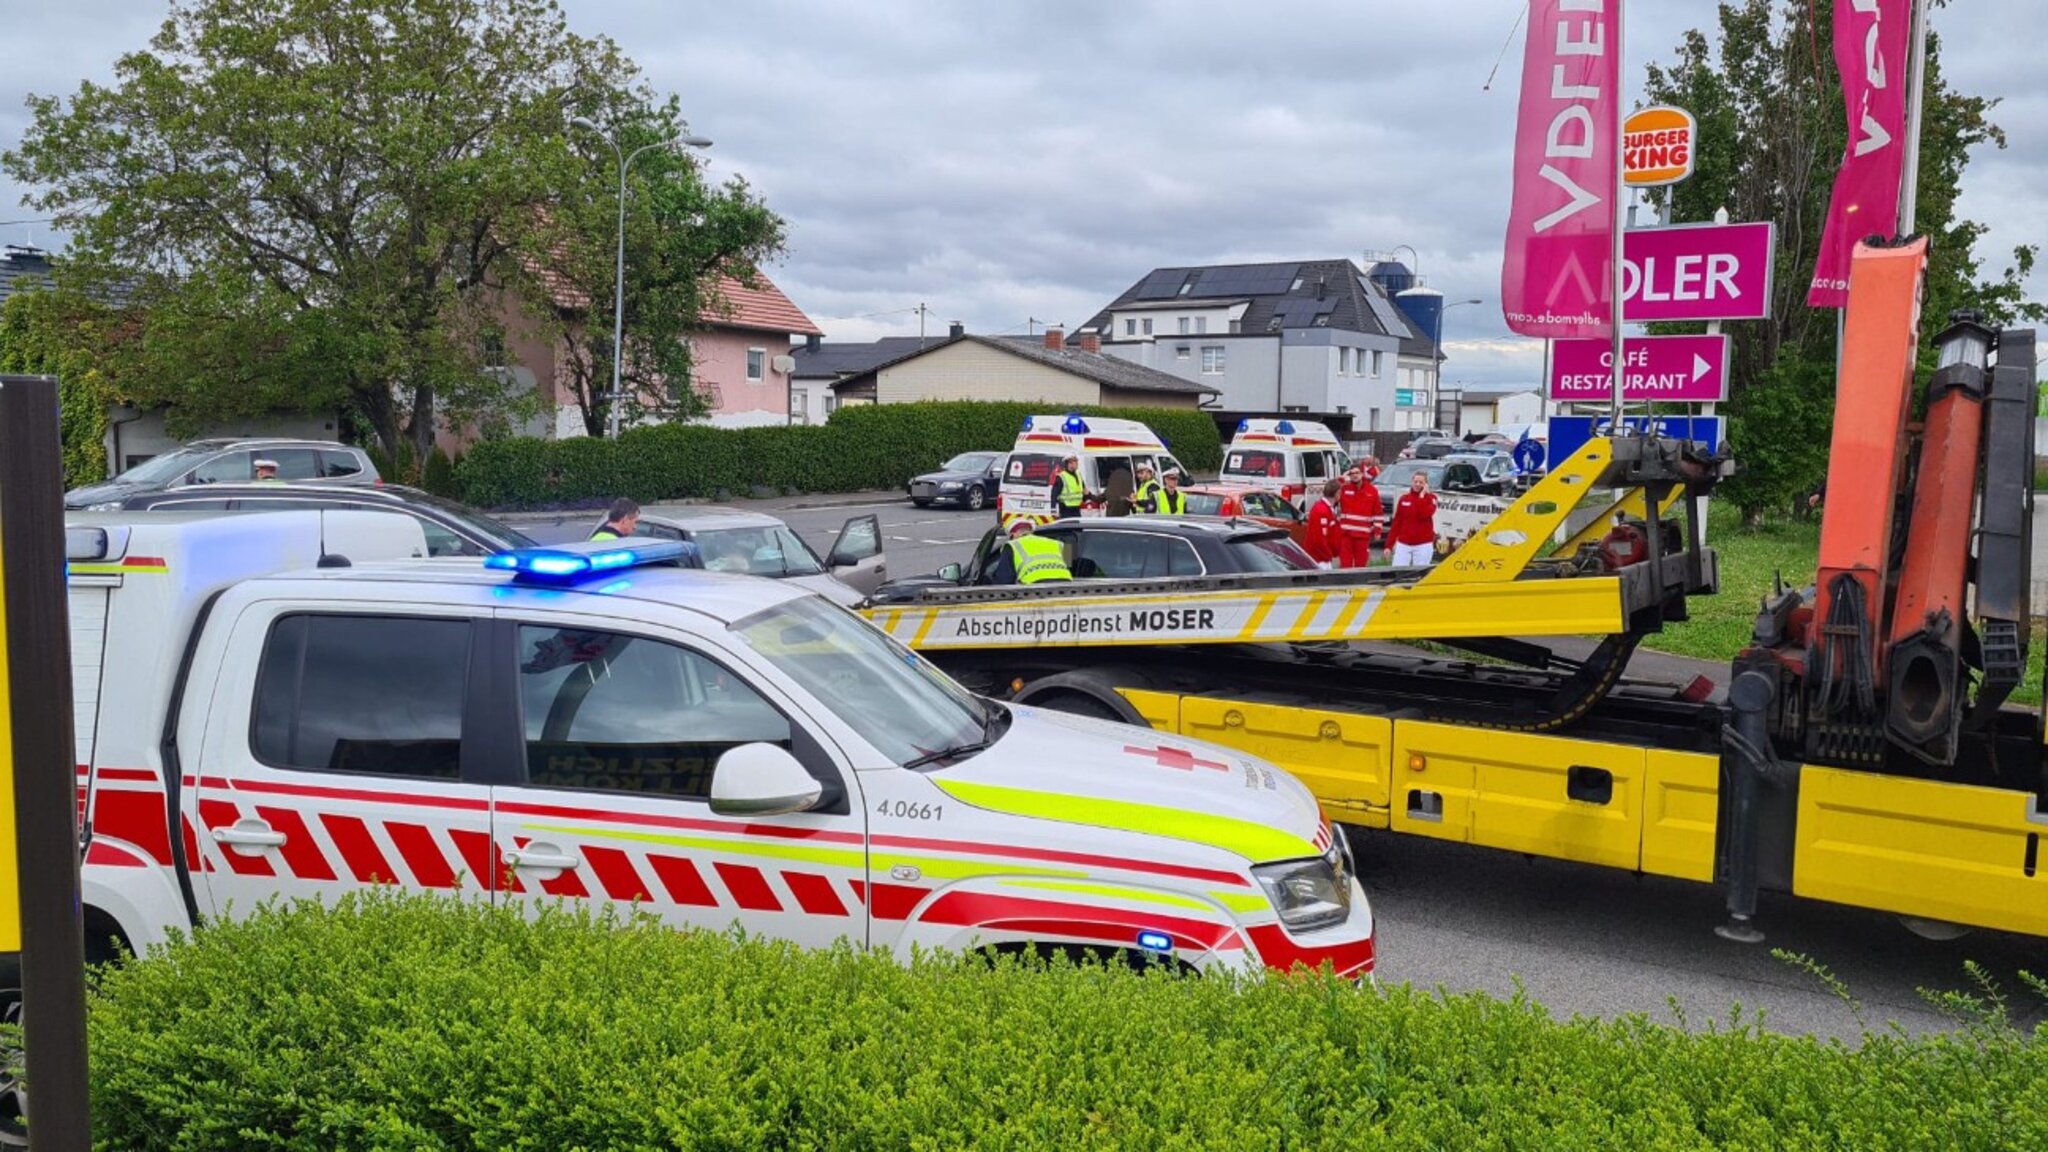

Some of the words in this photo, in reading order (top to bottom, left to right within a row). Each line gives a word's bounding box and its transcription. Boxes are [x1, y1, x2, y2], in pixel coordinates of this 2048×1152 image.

[1624, 145, 1688, 170] KING
[956, 614, 1122, 638] Abschleppdienst
[1129, 609, 1214, 631] MOSER
[877, 798, 942, 821] 4.0661
